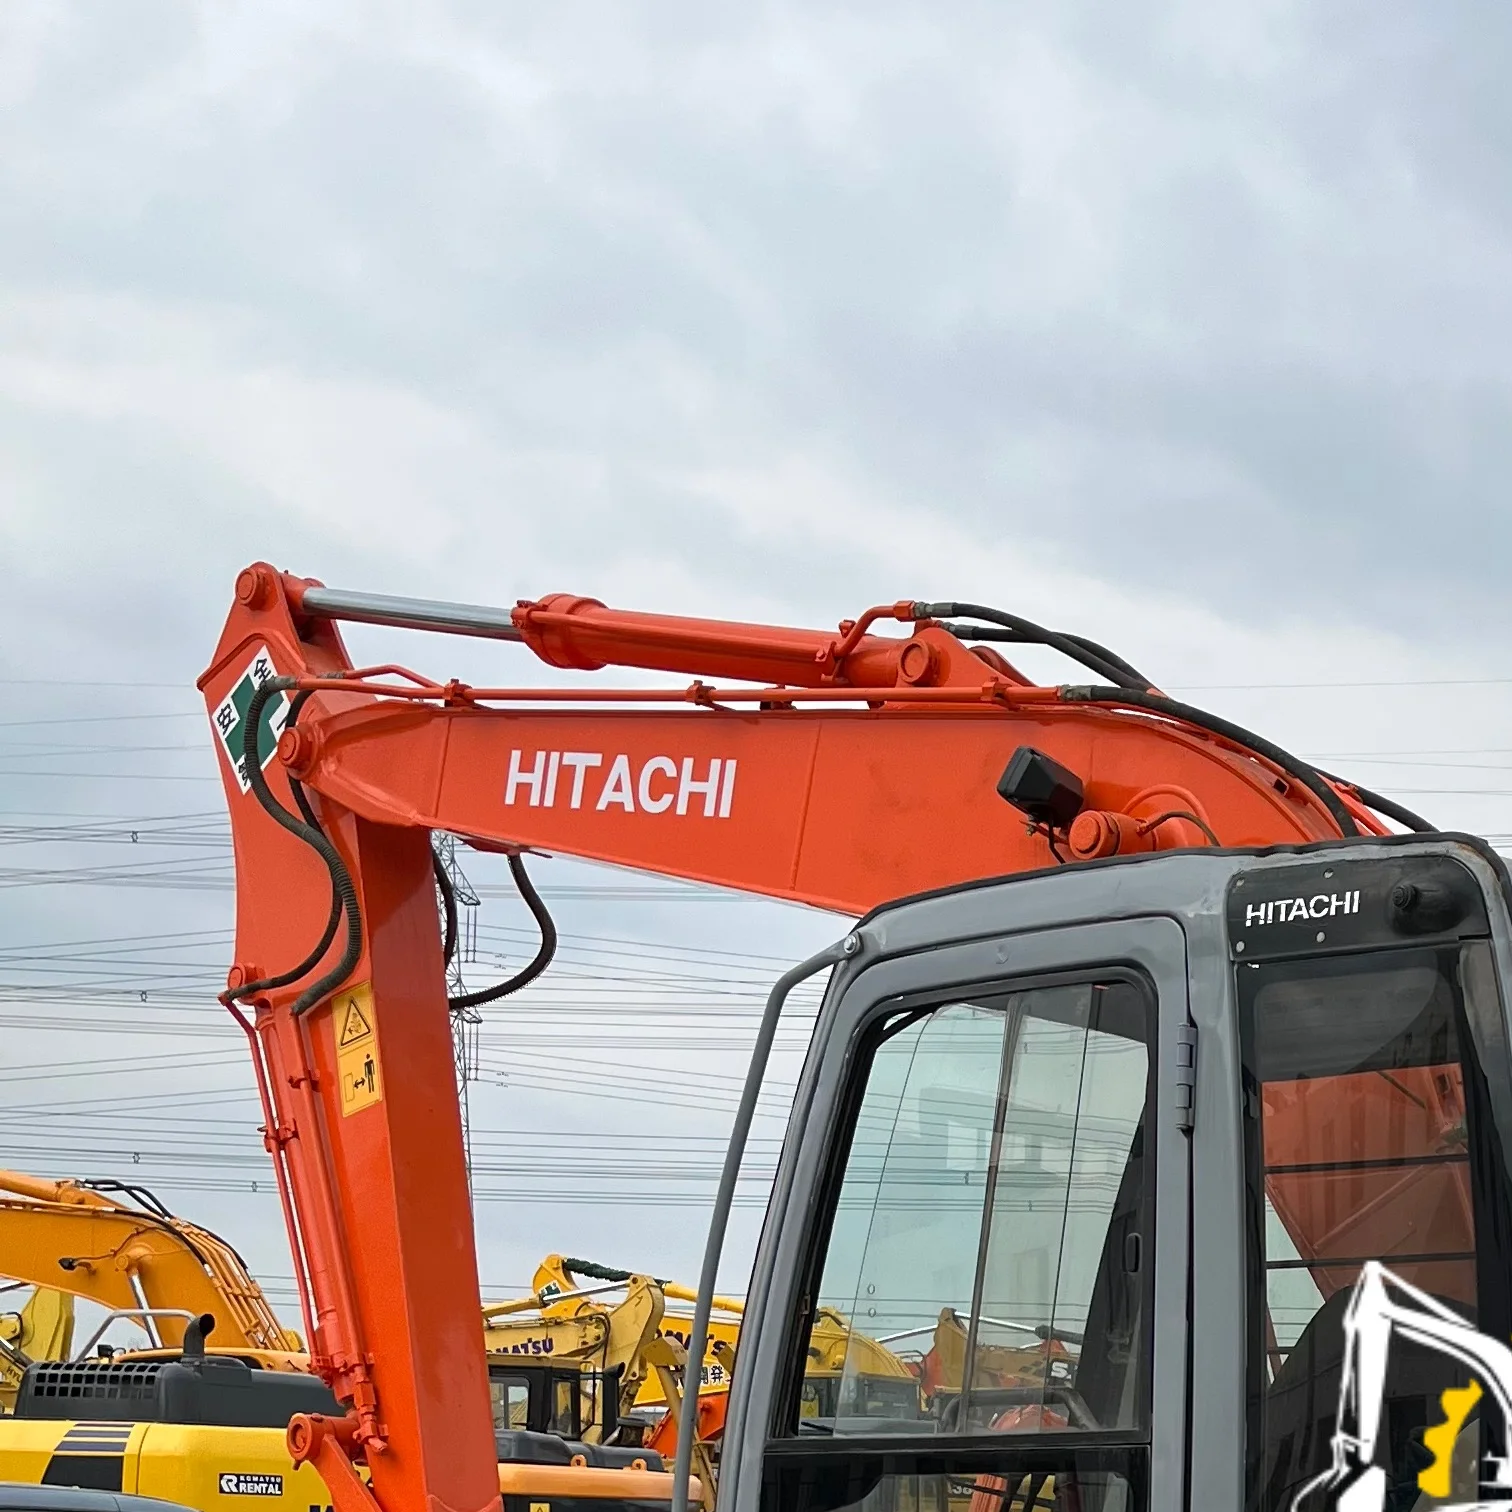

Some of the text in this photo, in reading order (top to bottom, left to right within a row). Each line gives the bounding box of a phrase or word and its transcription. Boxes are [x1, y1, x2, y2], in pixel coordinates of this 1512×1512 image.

[503, 748, 738, 819] HITACHI
[1245, 890, 1360, 927] HITACHI
[239, 1482, 282, 1495] RENTAL
